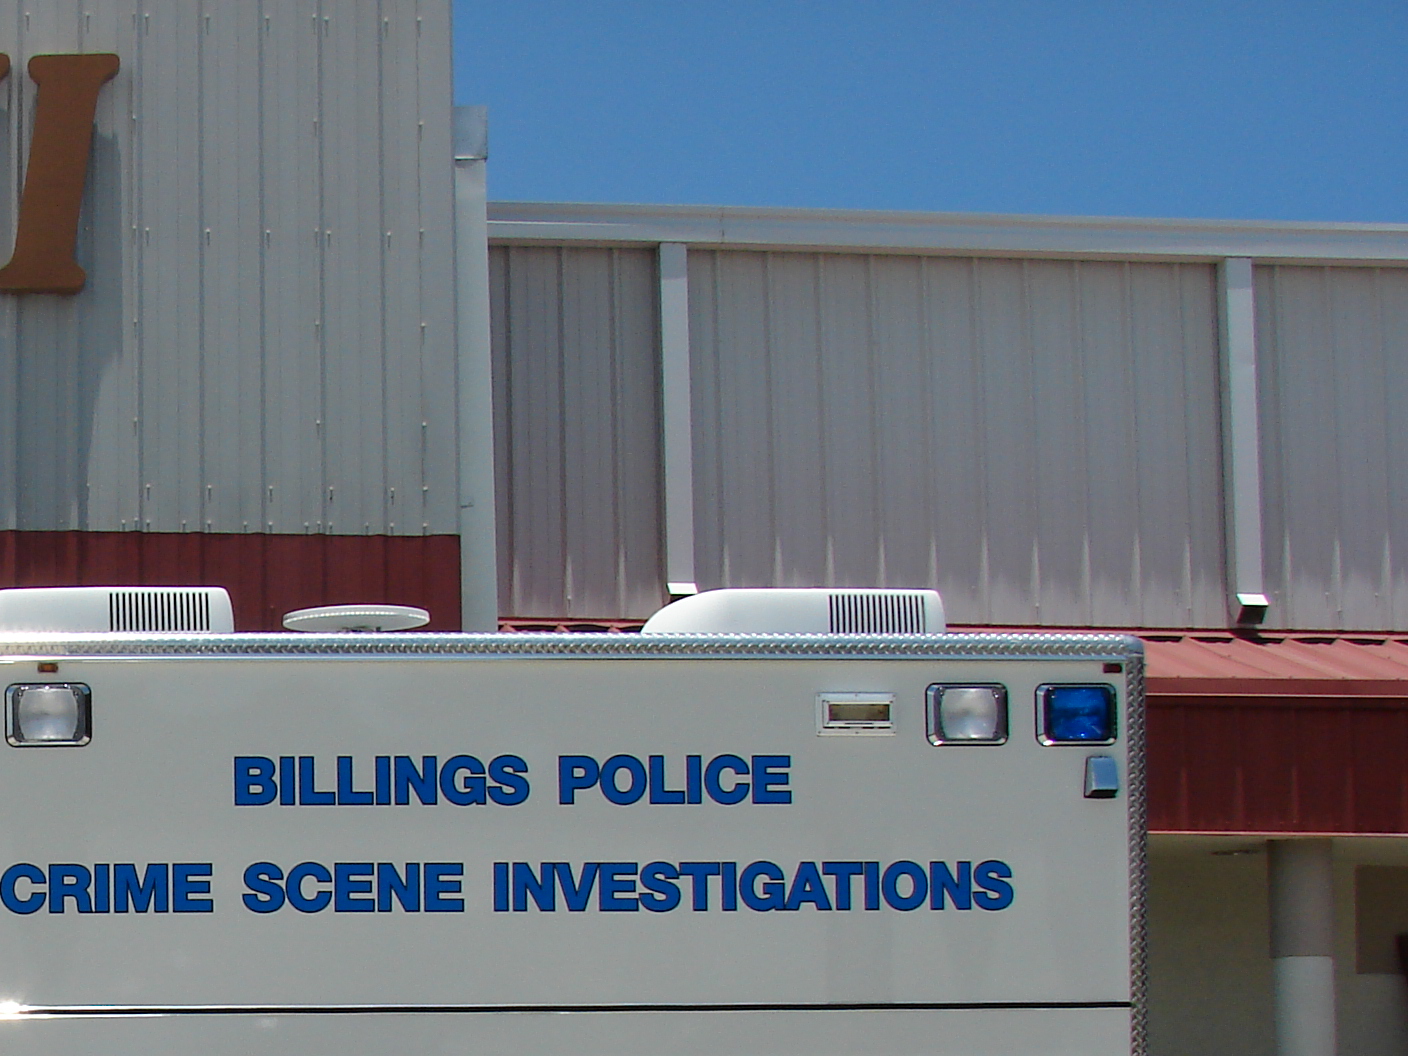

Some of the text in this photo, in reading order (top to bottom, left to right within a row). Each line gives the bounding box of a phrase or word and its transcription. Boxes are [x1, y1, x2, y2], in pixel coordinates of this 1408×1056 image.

[234, 754, 793, 807] BILLINGS POLICE
[0, 860, 1015, 915] CRIME SCENE INVESTIGATIONS
